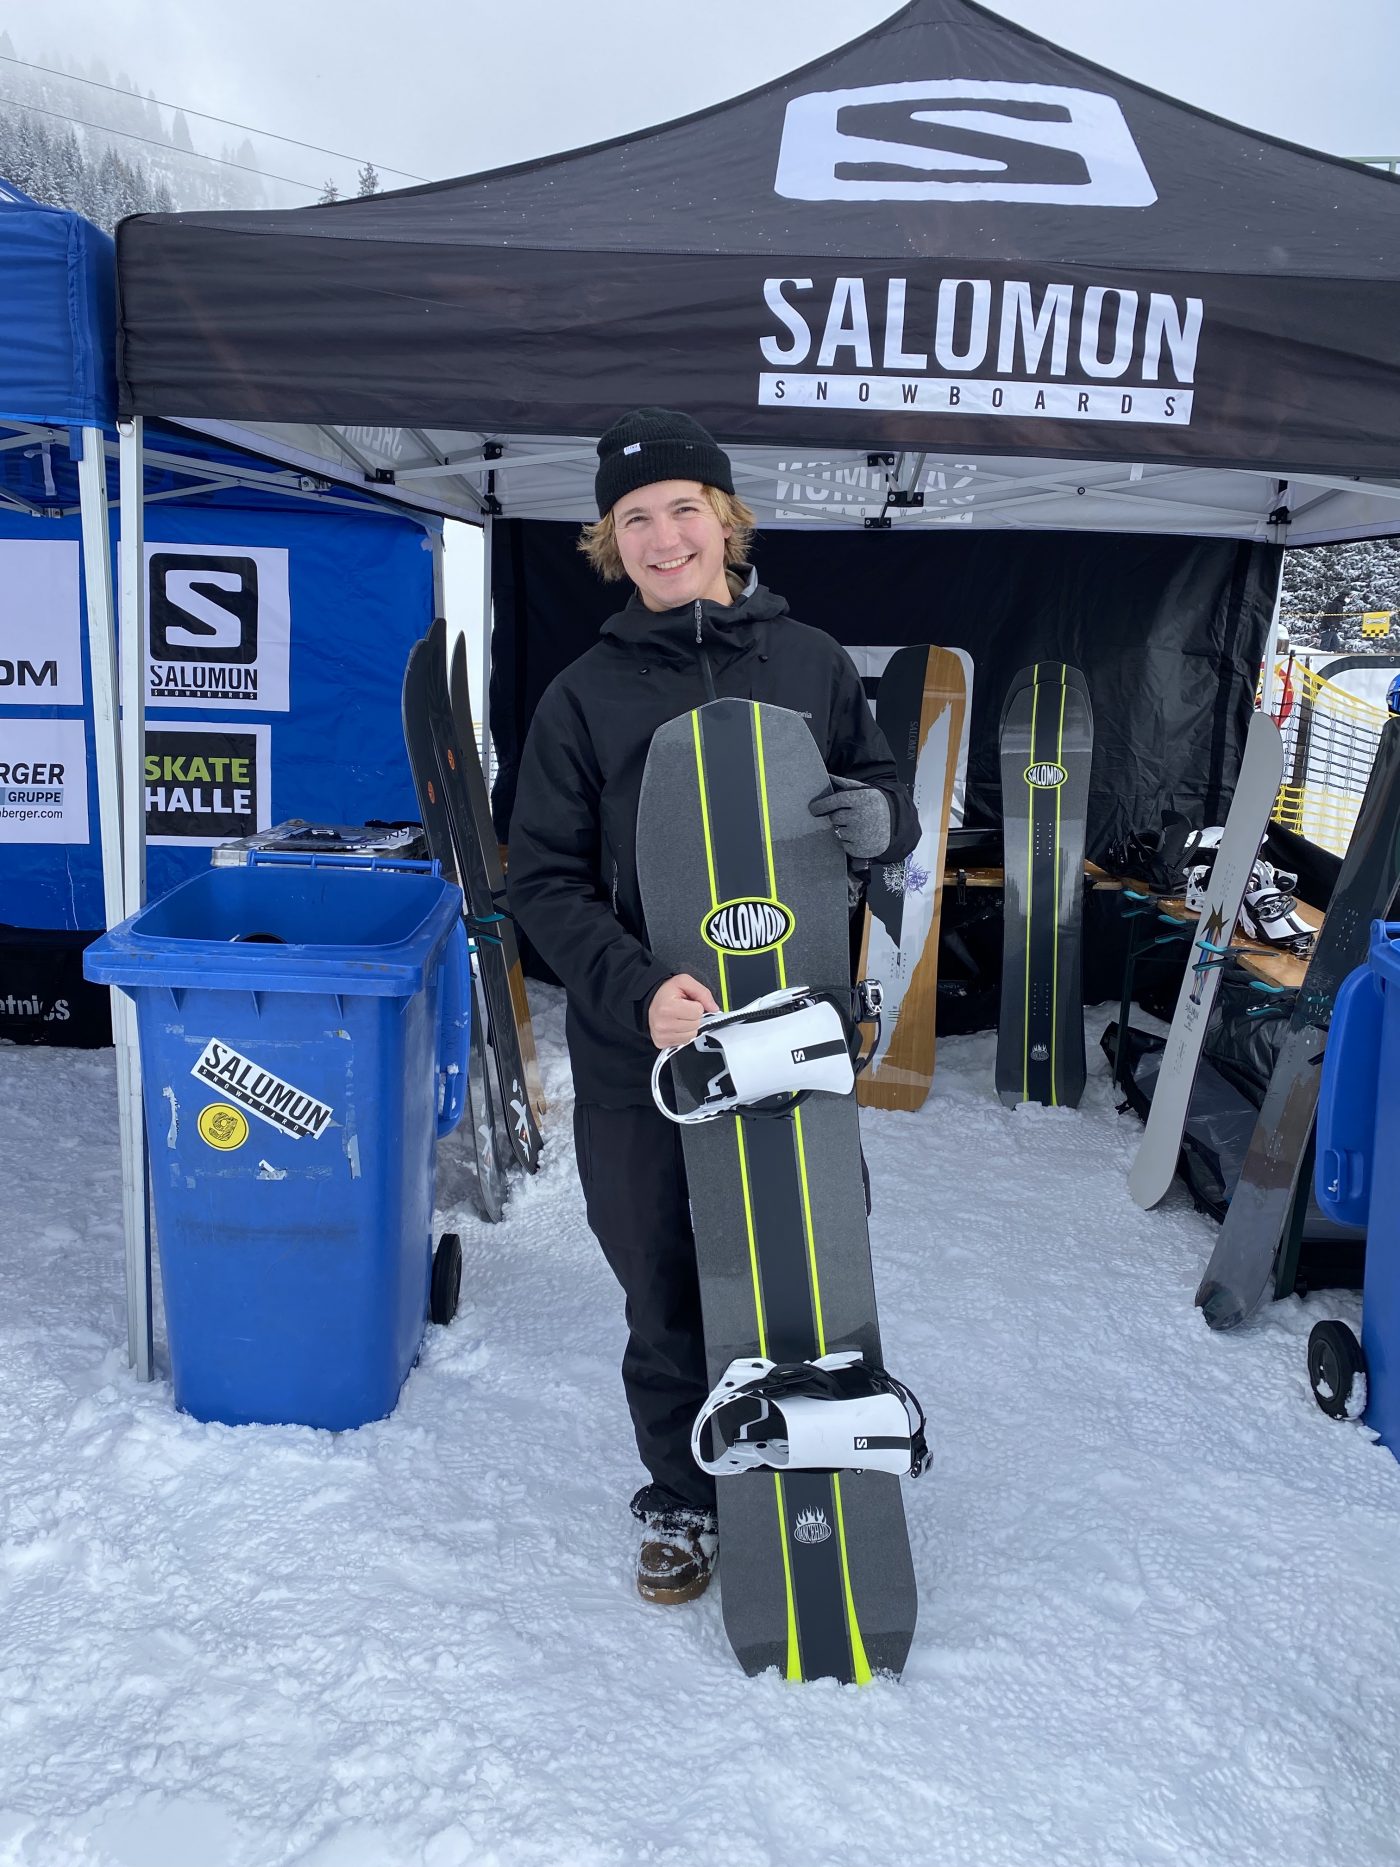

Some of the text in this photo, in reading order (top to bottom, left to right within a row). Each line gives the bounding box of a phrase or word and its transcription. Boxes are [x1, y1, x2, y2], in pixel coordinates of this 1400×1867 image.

[759, 277, 1204, 384] SALOMON
[774, 380, 1176, 418] SNOWBOARDS
[150, 665, 258, 691] SALOMON
[144, 755, 250, 783] SKATE
[1027, 764, 1064, 786] SALOMON
[8, 791, 62, 803] GRUPPE
[145, 786, 251, 815] HALLE
[0, 807, 63, 821] berger.com
[709, 903, 786, 949] SALOMON
[204, 1043, 331, 1132] SALOMON
